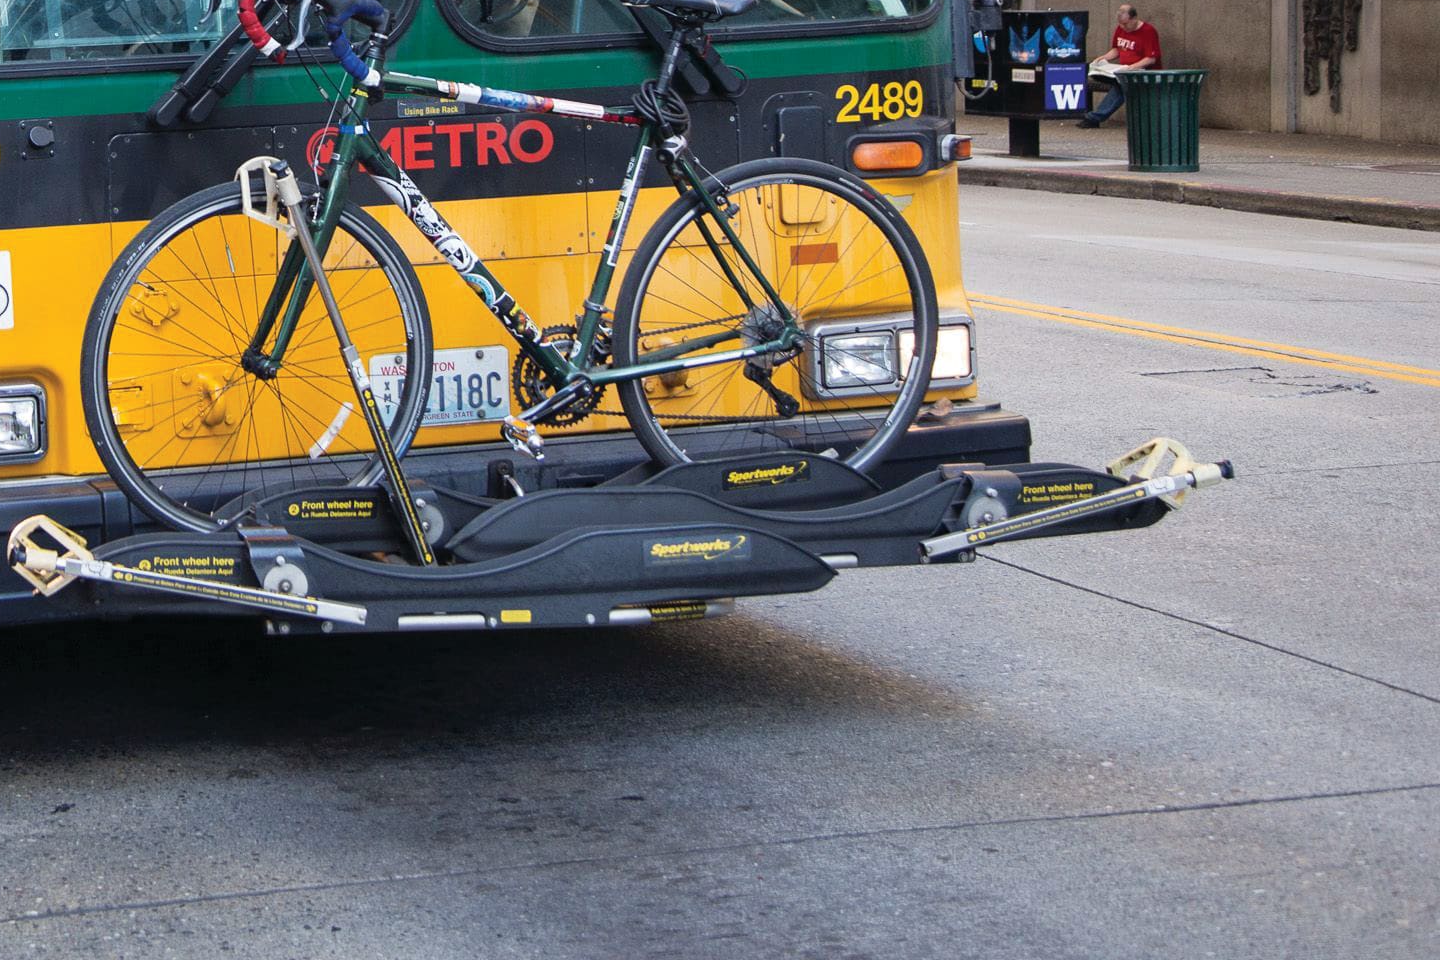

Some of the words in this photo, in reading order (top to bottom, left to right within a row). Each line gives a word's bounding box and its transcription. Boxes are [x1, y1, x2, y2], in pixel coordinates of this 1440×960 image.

[835, 80, 923, 123] 2489
[1050, 84, 1084, 110] W
[727, 465, 795, 484] Sportworks
[1023, 485, 1046, 494] Front
[1048, 483, 1073, 492] wheel
[1074, 482, 1094, 490] here
[301, 501, 324, 510] Front
[327, 500, 352, 509] wheel
[354, 500, 373, 508] here
[650, 538, 731, 558] Sportworks
[153, 556, 179, 566] Front
[182, 556, 210, 566] wheel
[213, 556, 235, 566] here
